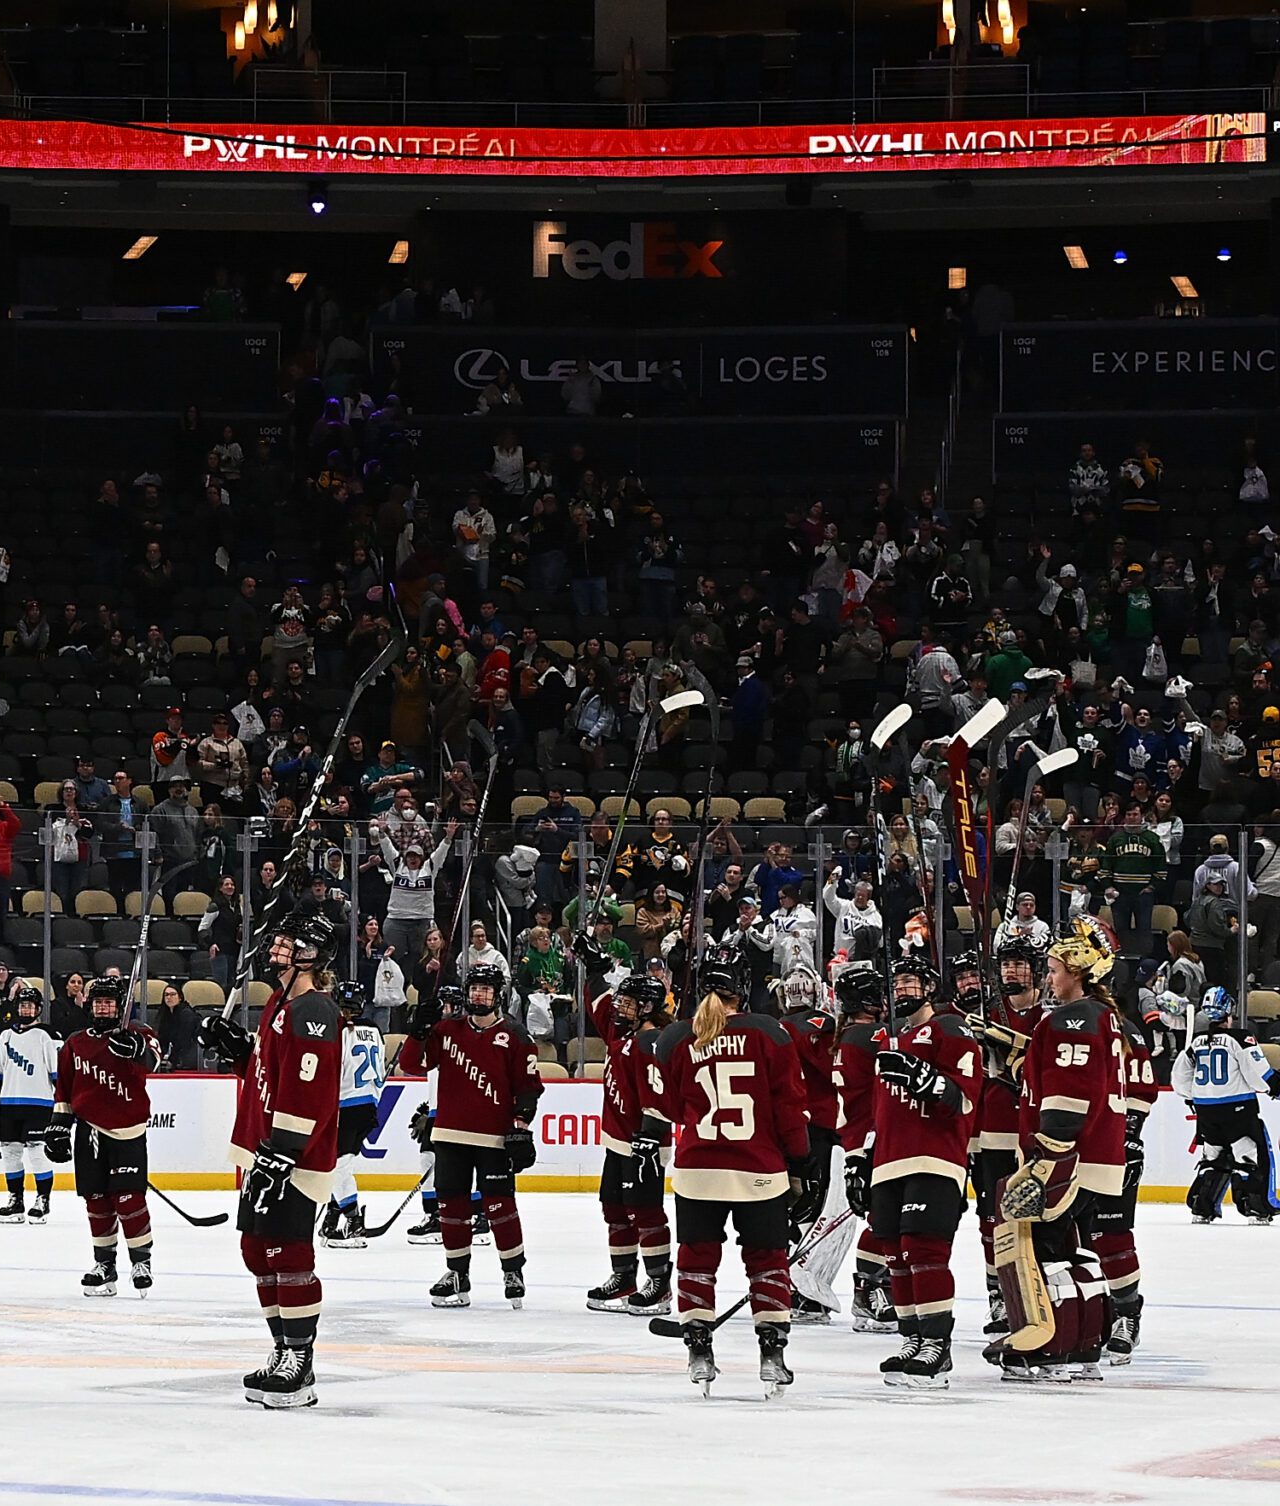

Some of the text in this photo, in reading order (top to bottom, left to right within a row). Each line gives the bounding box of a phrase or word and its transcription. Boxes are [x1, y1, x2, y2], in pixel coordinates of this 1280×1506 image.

[183, 133, 309, 163] PWHL
[531, 220, 726, 280] FedEx
[1013, 337, 1037, 347] LOGE
[720, 355, 829, 384] LOGES
[1091, 349, 1278, 375] EXPERIENC
[1005, 426, 1029, 436] LOGE
[954, 768, 979, 880] TRUE
[1115, 843, 1152, 857] CLARKSON
[398, 877, 427, 888] USA
[298, 1051, 320, 1083] 9
[955, 1050, 976, 1079] 4
[1054, 1042, 1091, 1068] 35
[1194, 1047, 1229, 1086] 50
[72, 1052, 133, 1103] ONTRÉAL
[442, 1035, 501, 1105] MONTRÉAL
[693, 1061, 756, 1141] 15
